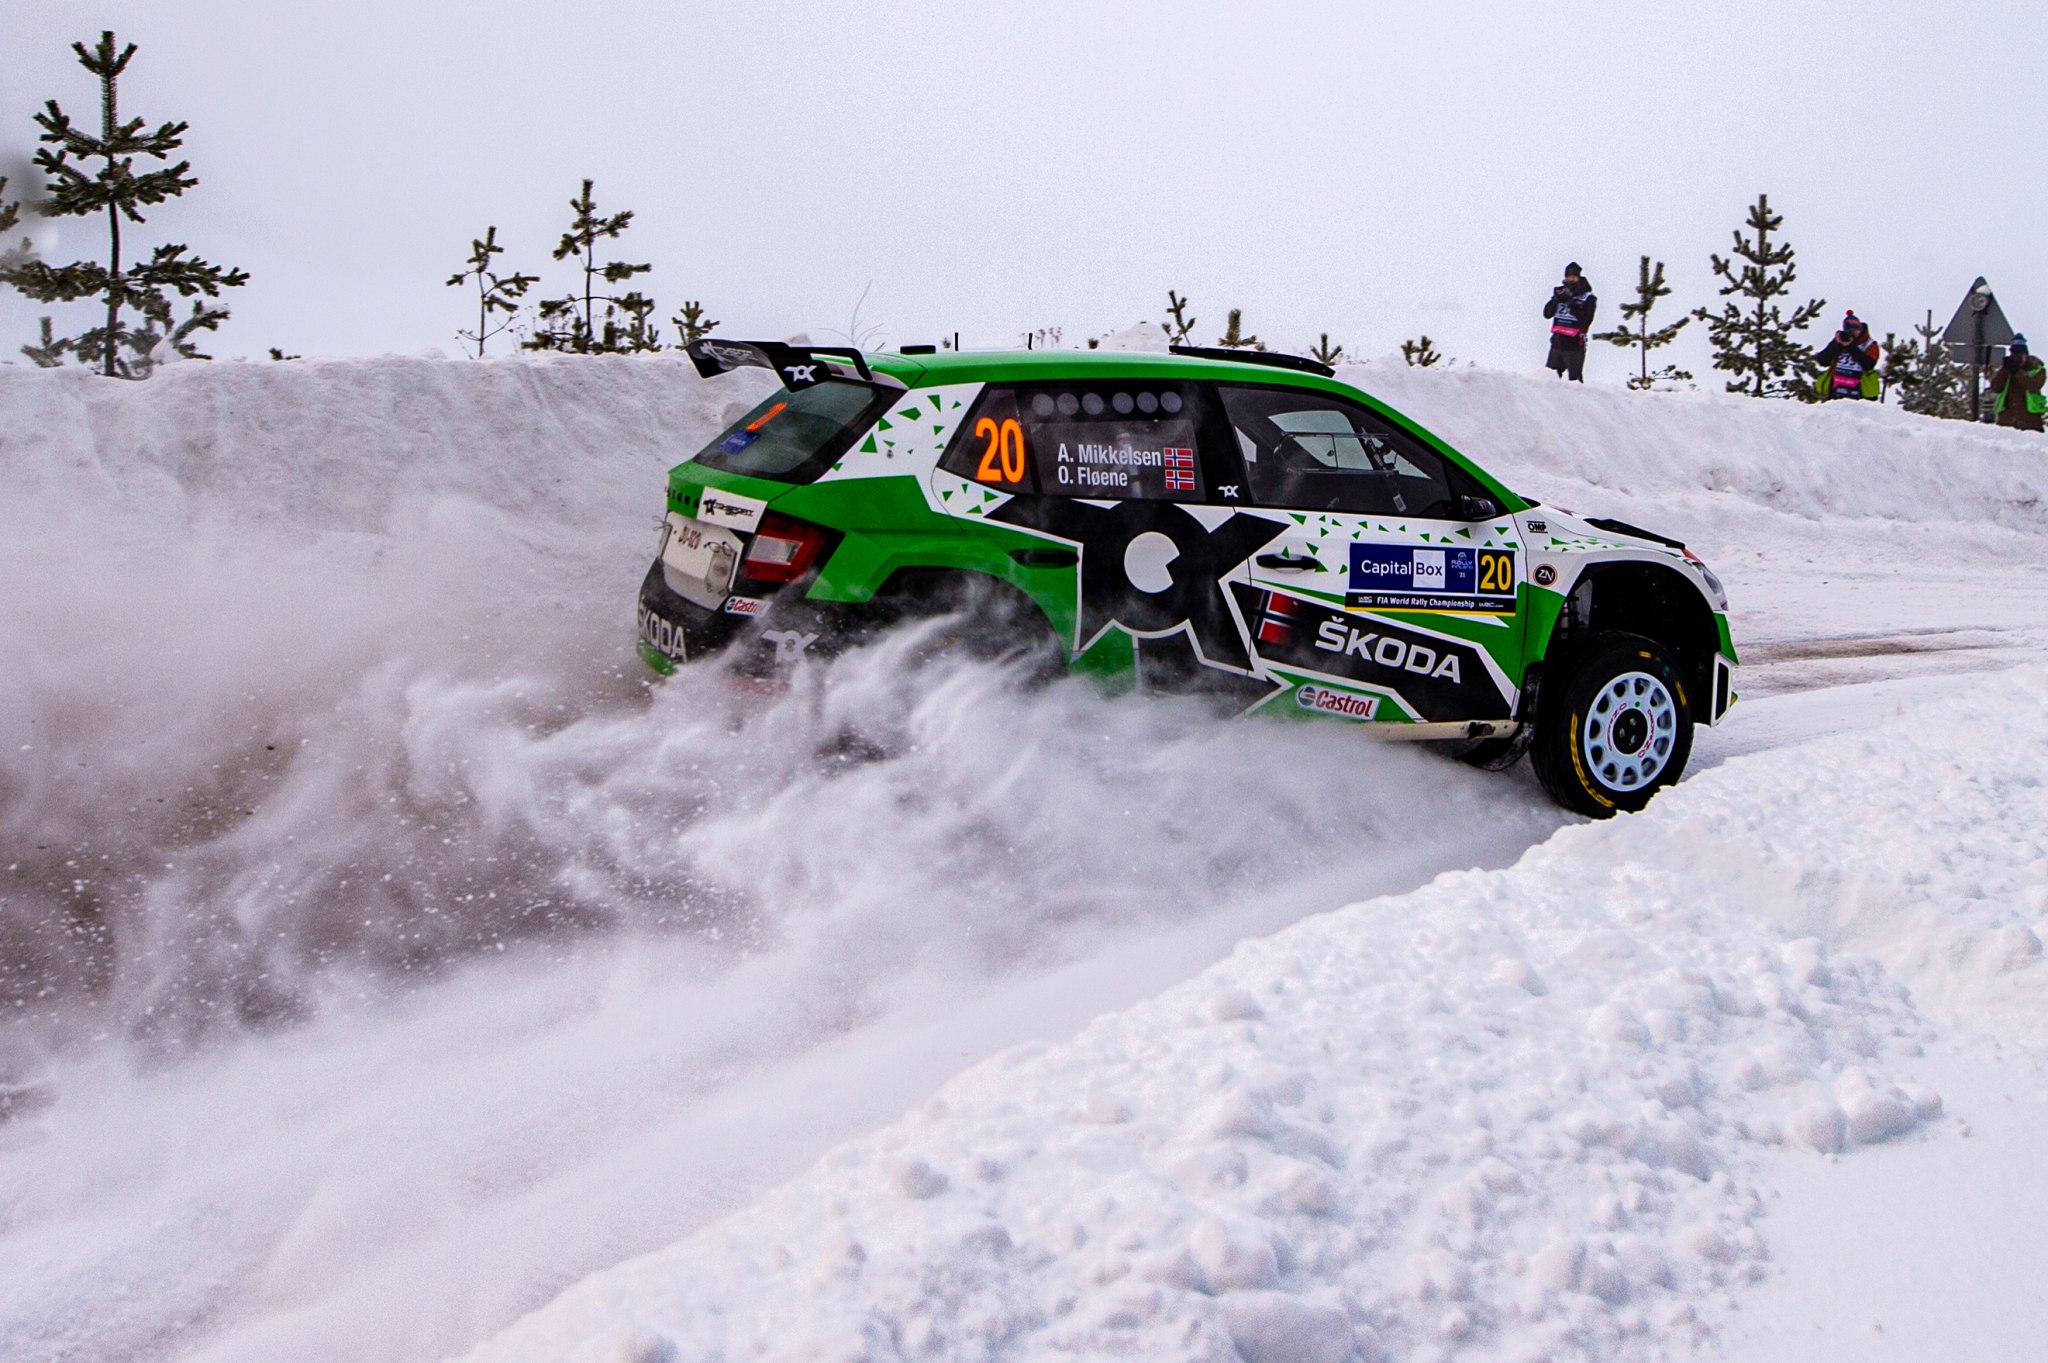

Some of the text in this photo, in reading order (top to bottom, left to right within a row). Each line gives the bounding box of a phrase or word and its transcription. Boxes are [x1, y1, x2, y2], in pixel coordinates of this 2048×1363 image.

[975, 416, 1025, 484] 20
[1057, 443, 1162, 468] A. Mikkelsen
[1057, 465, 1128, 488] O. Fløene
[1527, 523, 1547, 532] OMP
[1480, 554, 1512, 591] 20
[1538, 568, 1554, 582] ZN
[734, 598, 768, 614] Castro
[1377, 596, 1389, 605] FIA
[1389, 597, 1410, 606] World
[1411, 598, 1428, 607] Rally
[1429, 598, 1475, 609] Championship
[1315, 615, 1461, 684] ŠKODA
[1315, 690, 1373, 717] Castrol
